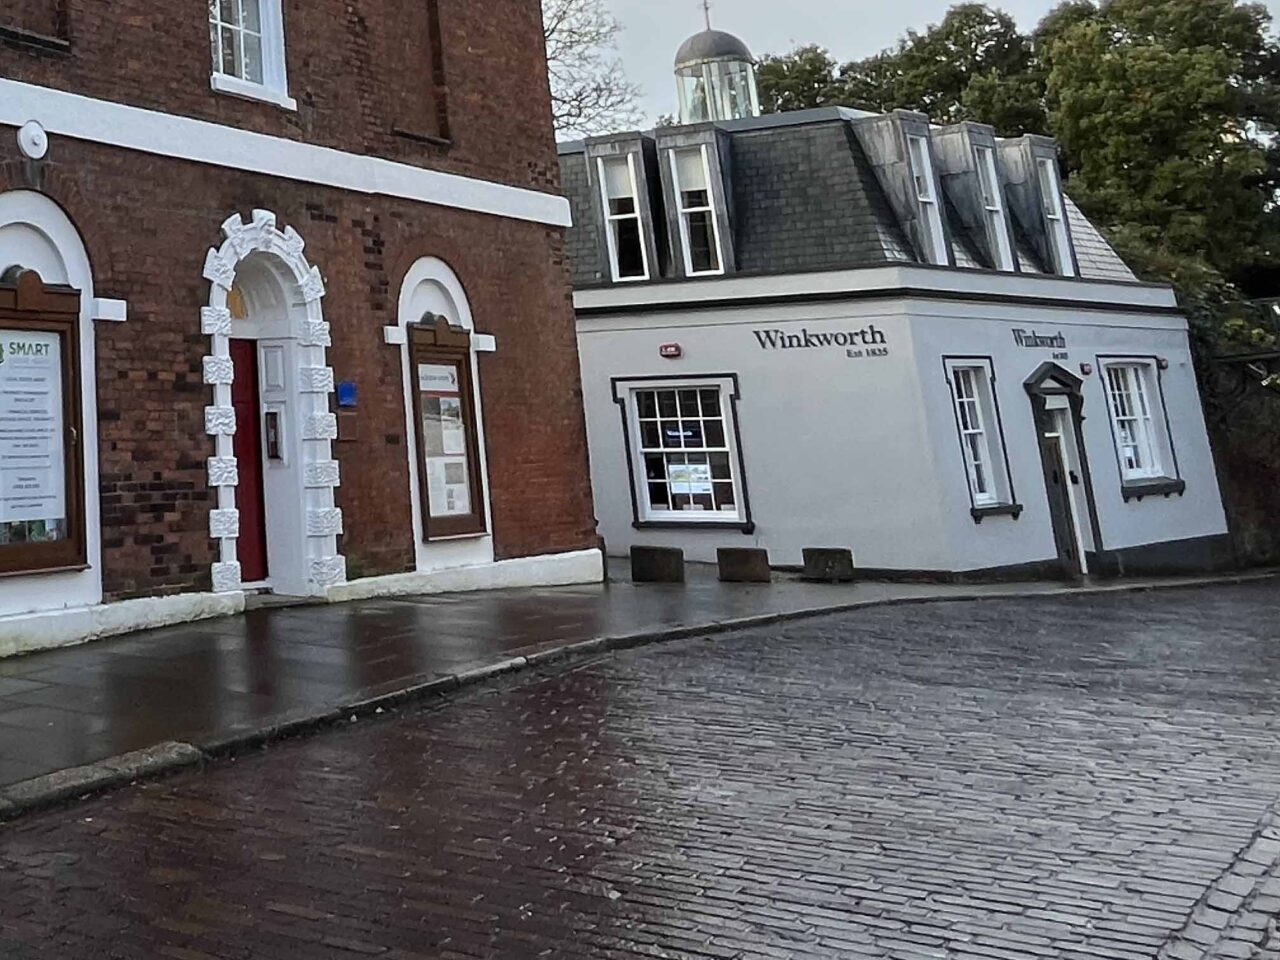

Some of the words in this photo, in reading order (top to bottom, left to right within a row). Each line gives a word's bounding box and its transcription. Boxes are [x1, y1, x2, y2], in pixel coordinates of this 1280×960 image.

[752, 324, 887, 349] Winkworth
[9, 341, 50, 356] SMART
[846, 349, 863, 358] Est
